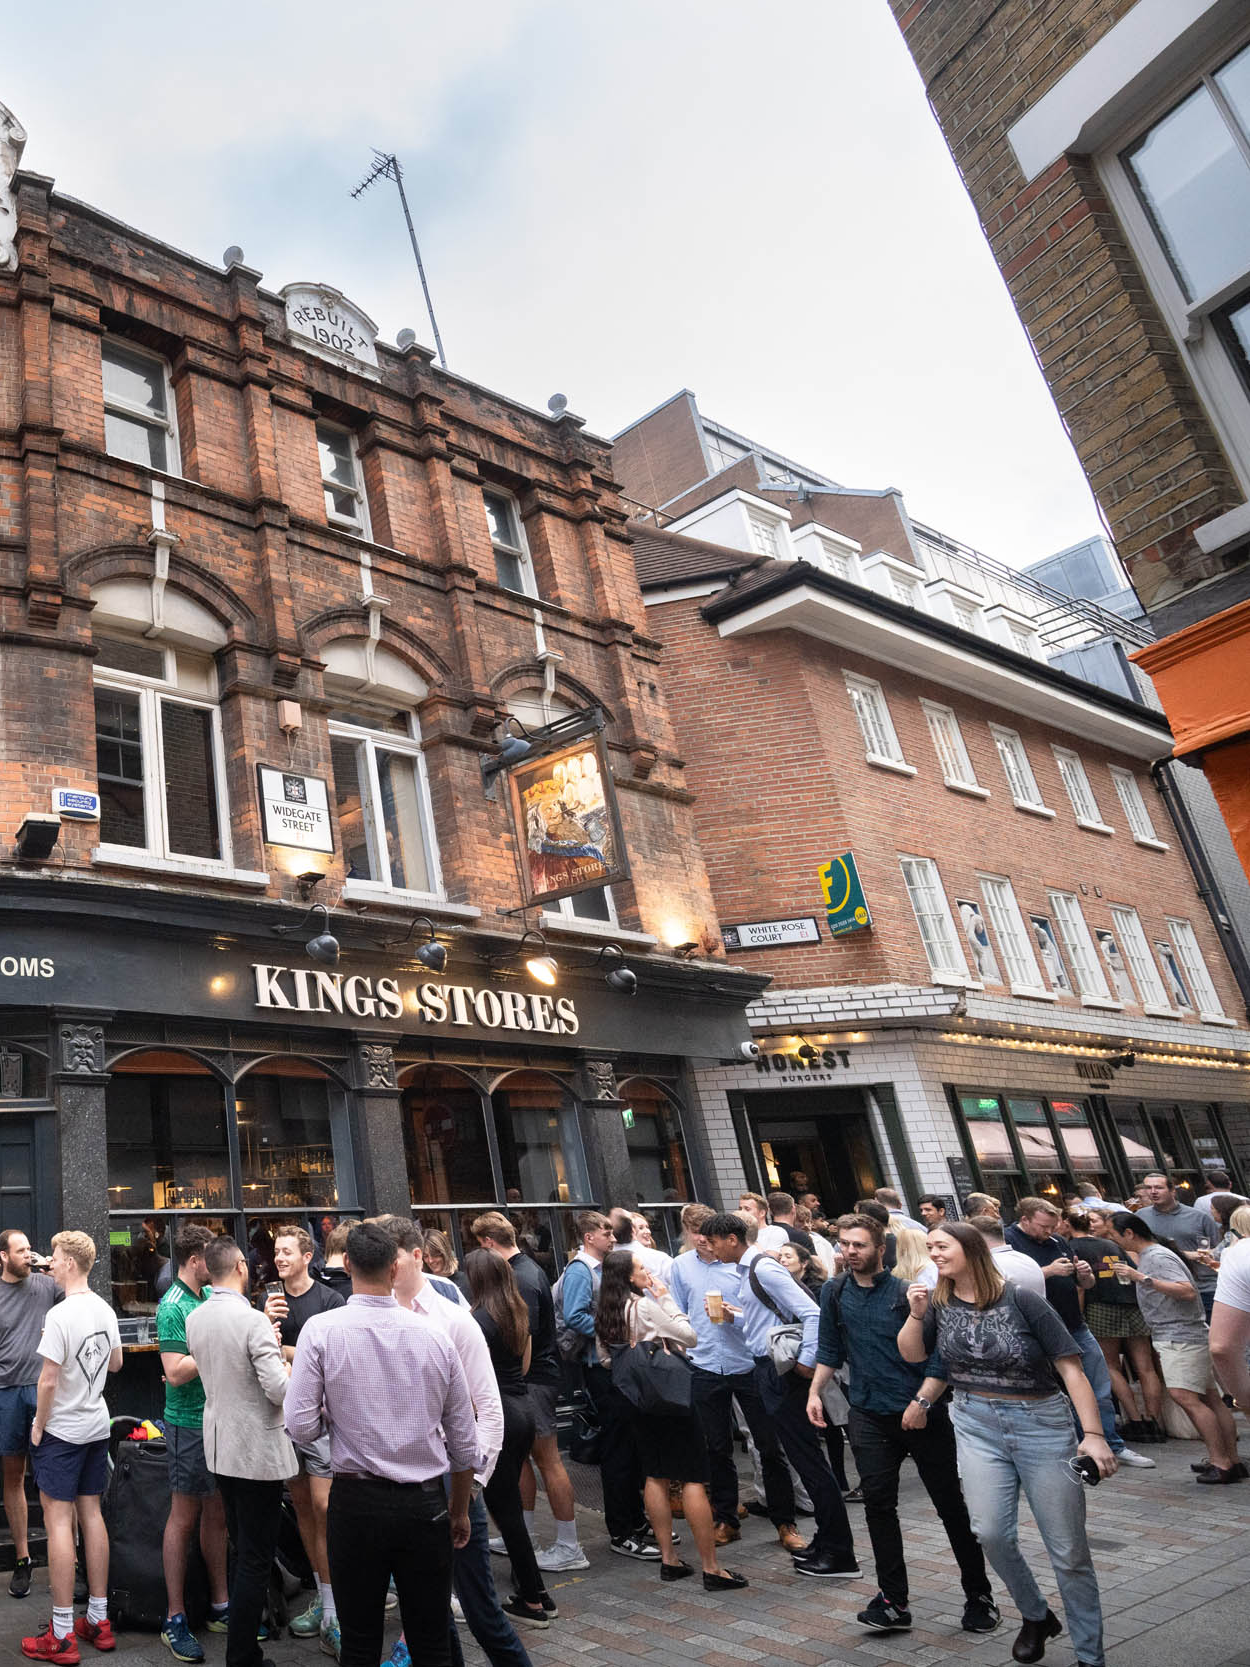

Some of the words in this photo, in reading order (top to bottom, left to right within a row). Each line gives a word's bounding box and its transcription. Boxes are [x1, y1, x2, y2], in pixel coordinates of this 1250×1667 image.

[293, 307, 368, 348] REBUILT
[312, 325, 355, 356] 1902
[272, 805, 322, 822] WIDEGATE
[282, 819, 315, 832] STREET
[748, 925, 779, 935] WHITE
[781, 922, 807, 931] ROSE
[750, 933, 783, 943] COURT
[251, 963, 402, 1019] KINGS
[421, 983, 580, 1035] STORES
[782, 1074, 832, 1082] BURGERS
